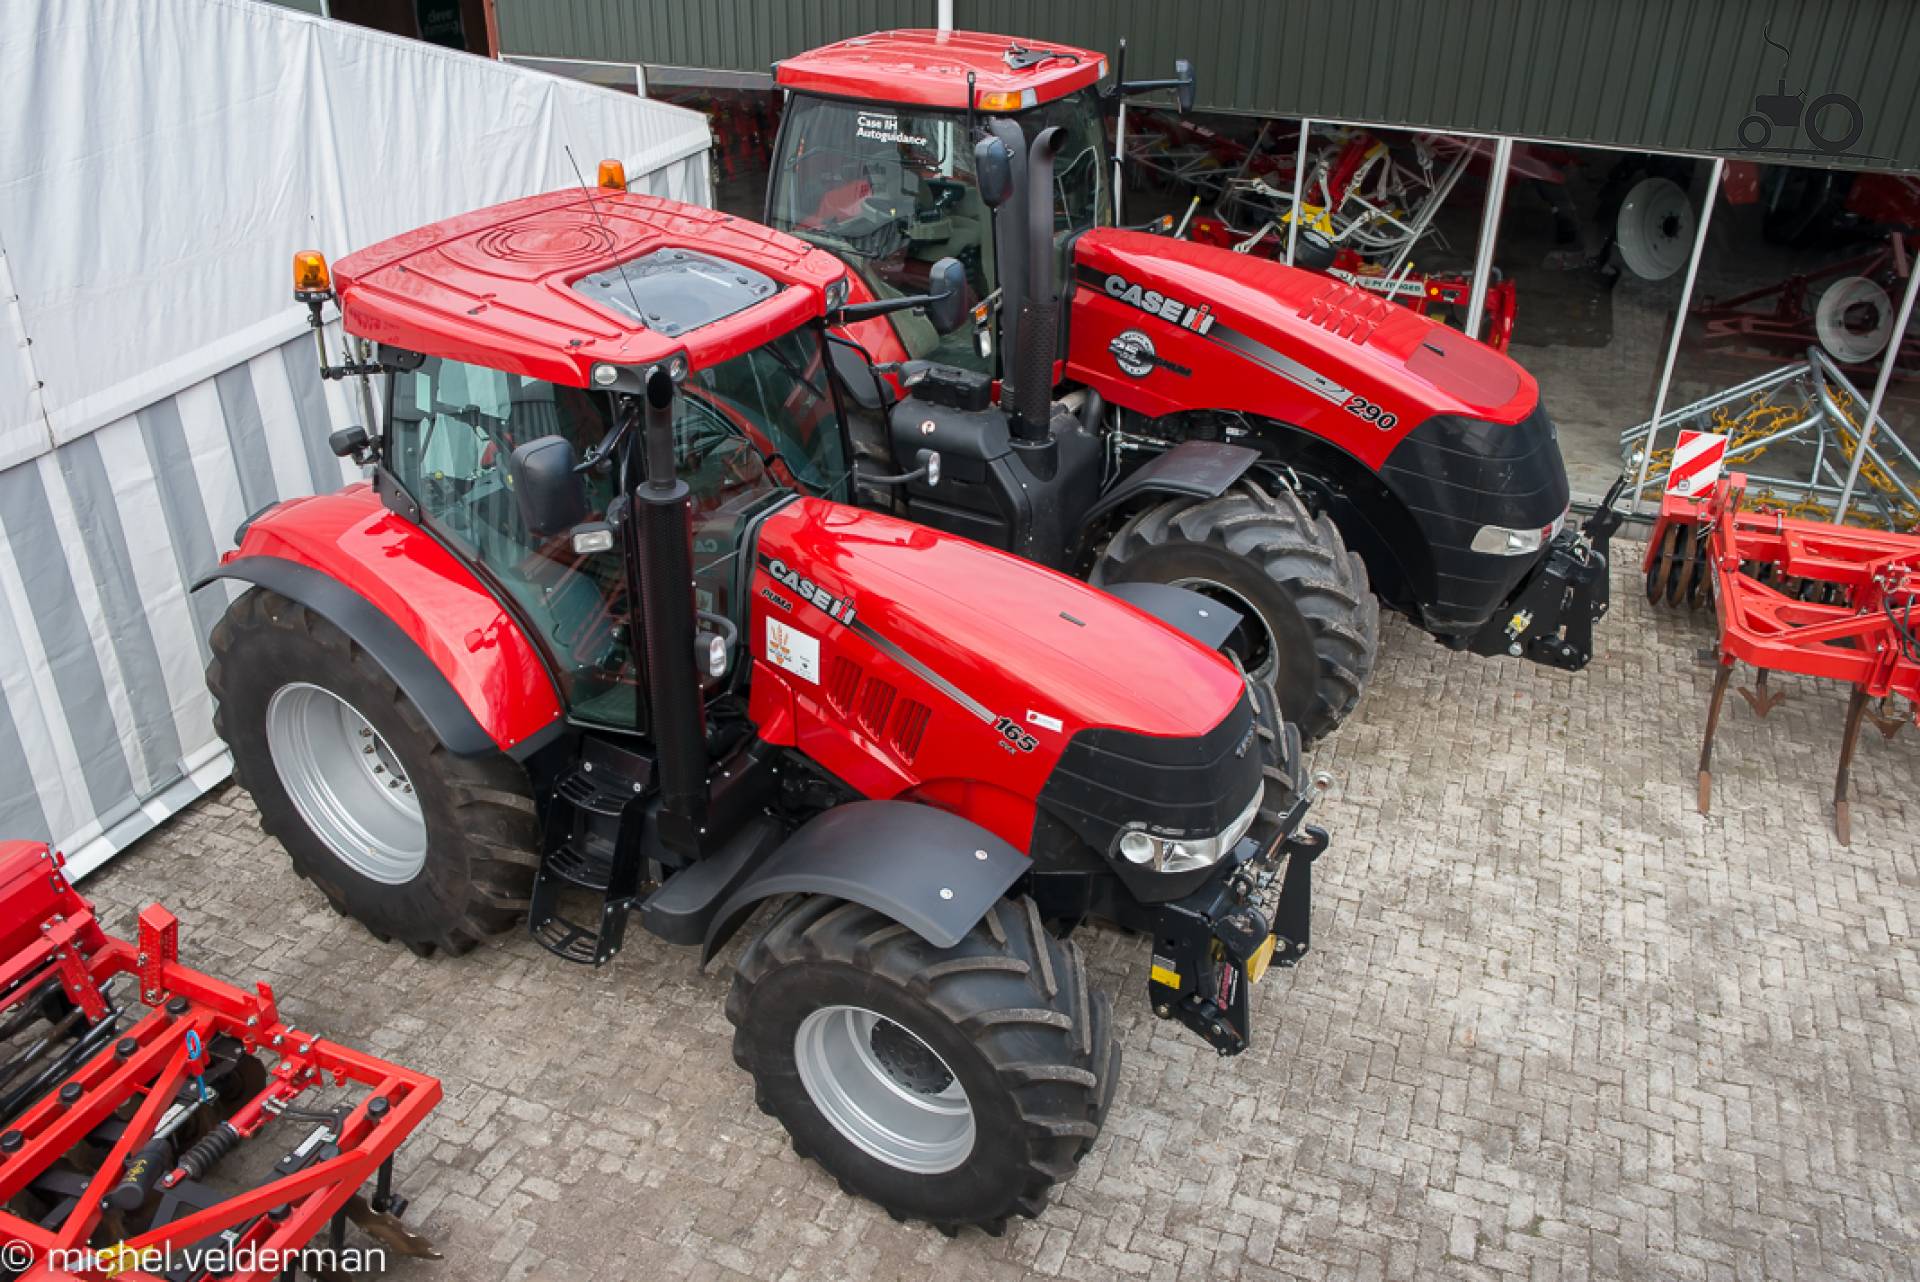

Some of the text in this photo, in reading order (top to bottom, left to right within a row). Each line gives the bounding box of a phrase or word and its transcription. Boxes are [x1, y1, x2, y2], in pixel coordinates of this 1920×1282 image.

[856, 127, 927, 146] Autoguidance
[857, 116, 882, 129] Case
[1105, 275, 1185, 323] CASE
[1345, 396, 1398, 432] 290
[760, 586, 793, 613] PUMA
[769, 560, 833, 611] CASE
[994, 716, 1039, 753] 165
